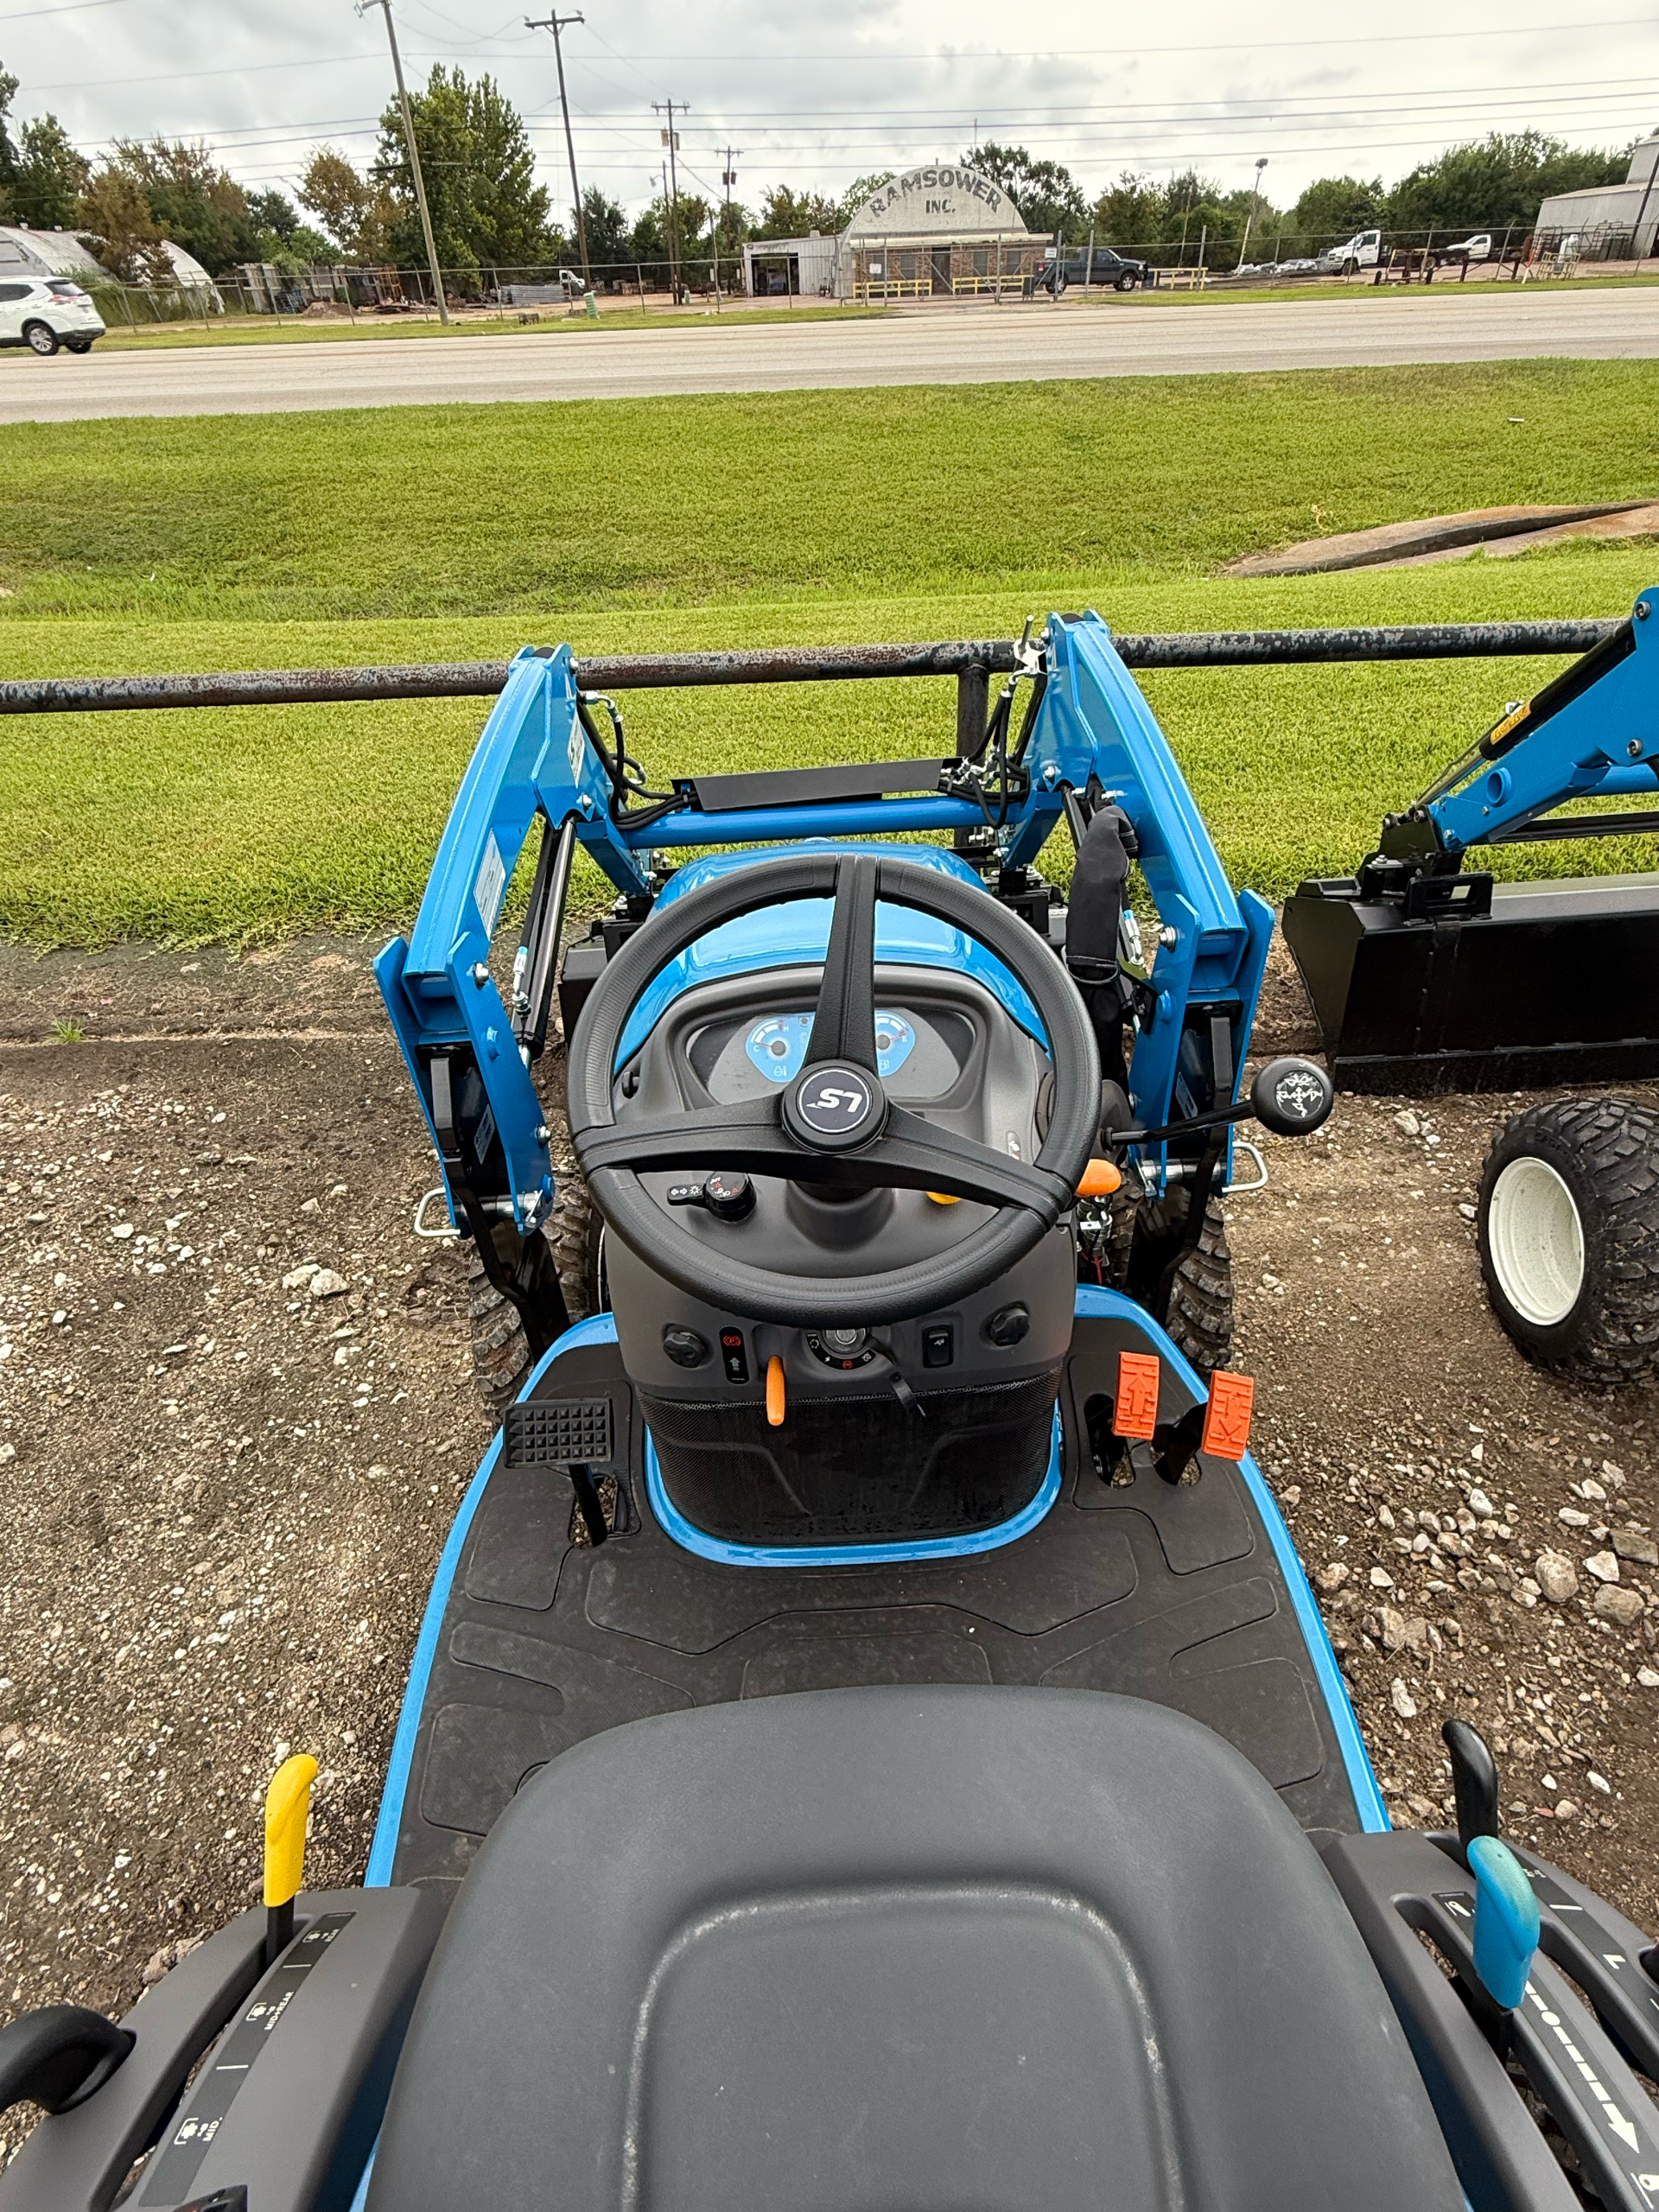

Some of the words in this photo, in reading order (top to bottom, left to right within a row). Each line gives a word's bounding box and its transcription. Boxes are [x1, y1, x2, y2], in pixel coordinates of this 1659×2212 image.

[869, 168, 1002, 217] RAMSOWER
[925, 199, 956, 214] INC.
[264, 1991, 295, 2031] MID+REAR
[202, 2116, 223, 2142] MID.
